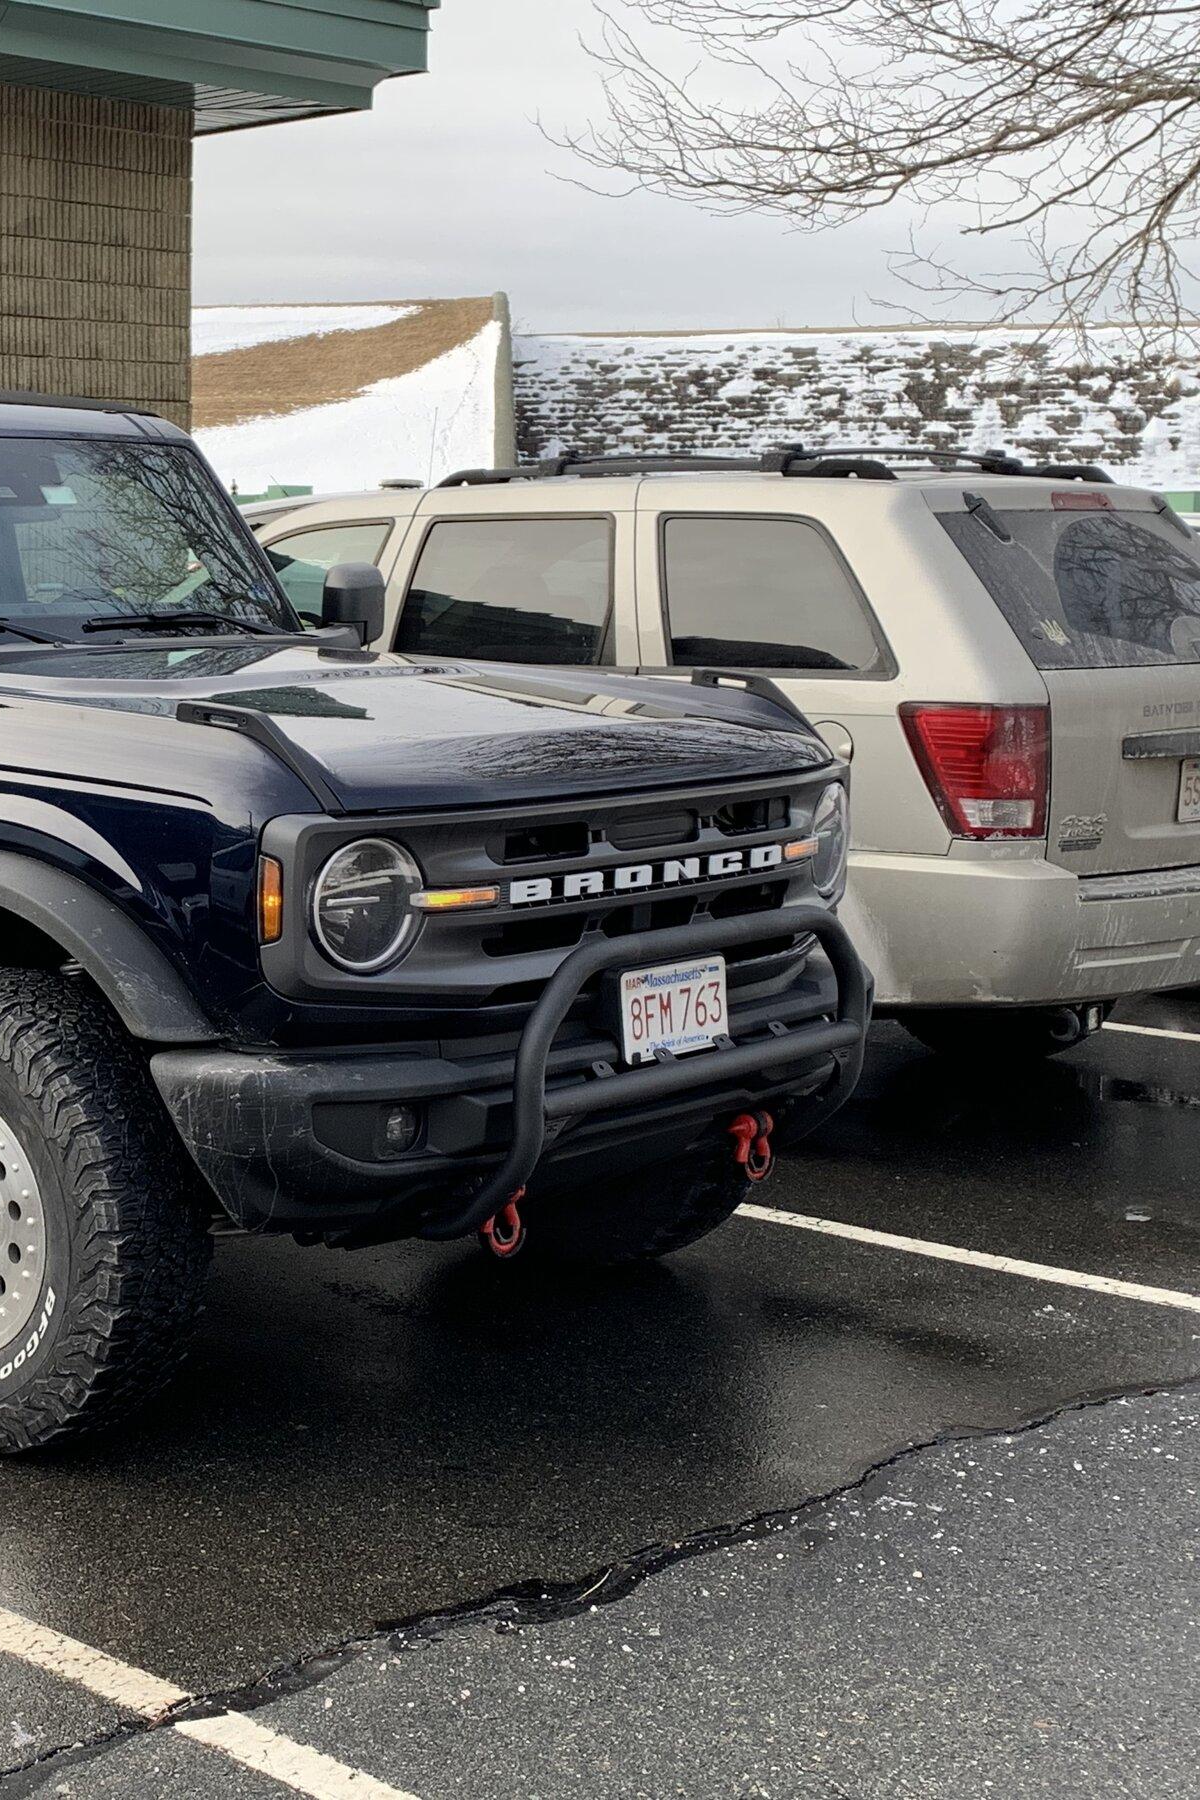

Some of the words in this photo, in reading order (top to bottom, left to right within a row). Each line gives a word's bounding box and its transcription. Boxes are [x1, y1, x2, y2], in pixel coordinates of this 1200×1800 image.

[509, 844, 782, 904] BRONCO
[645, 968, 703, 988] Massachusetts
[631, 988, 673, 1040] 8FM
[680, 981, 722, 1031] 763
